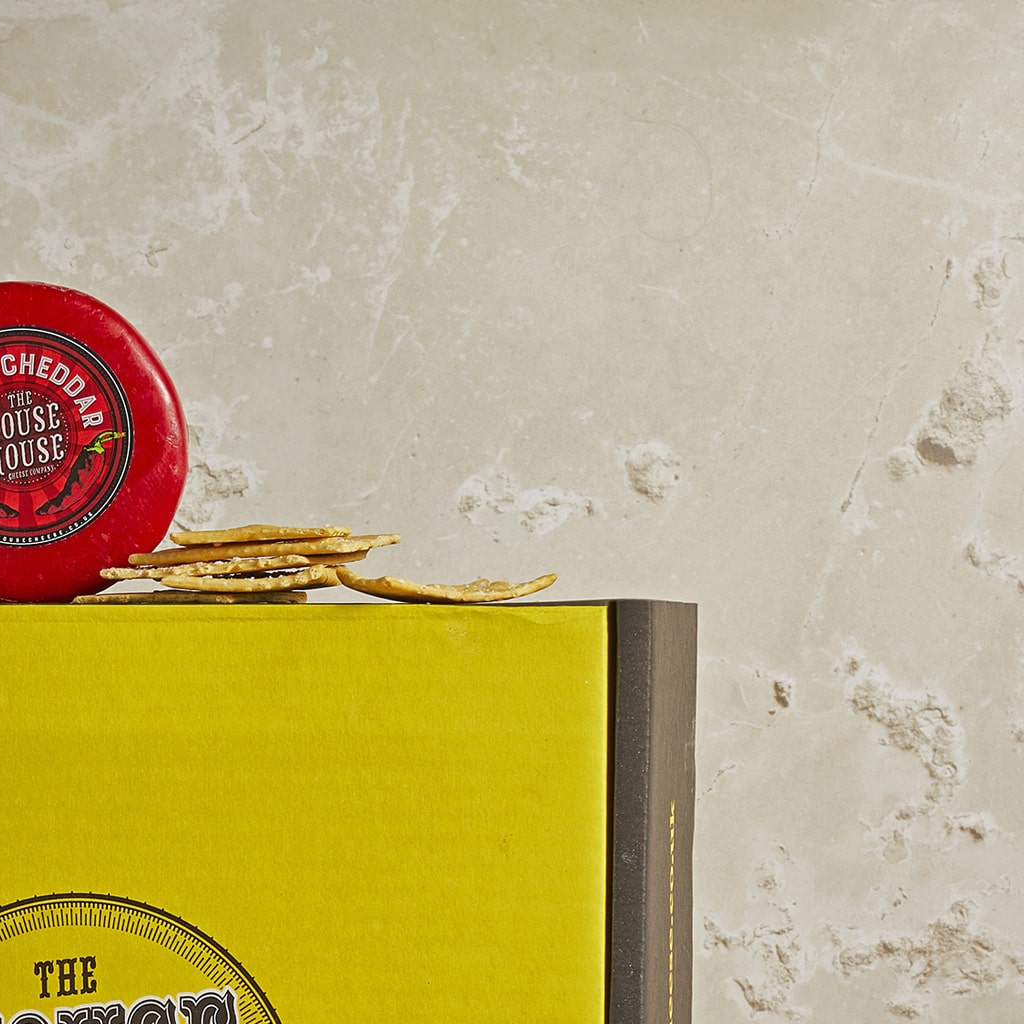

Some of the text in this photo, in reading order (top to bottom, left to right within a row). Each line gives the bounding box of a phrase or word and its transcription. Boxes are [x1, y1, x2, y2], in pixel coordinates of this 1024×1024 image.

[0, 353, 104, 429] CHEDDAR
[7, 391, 33, 408] THE
[34, 956, 97, 998] THE
